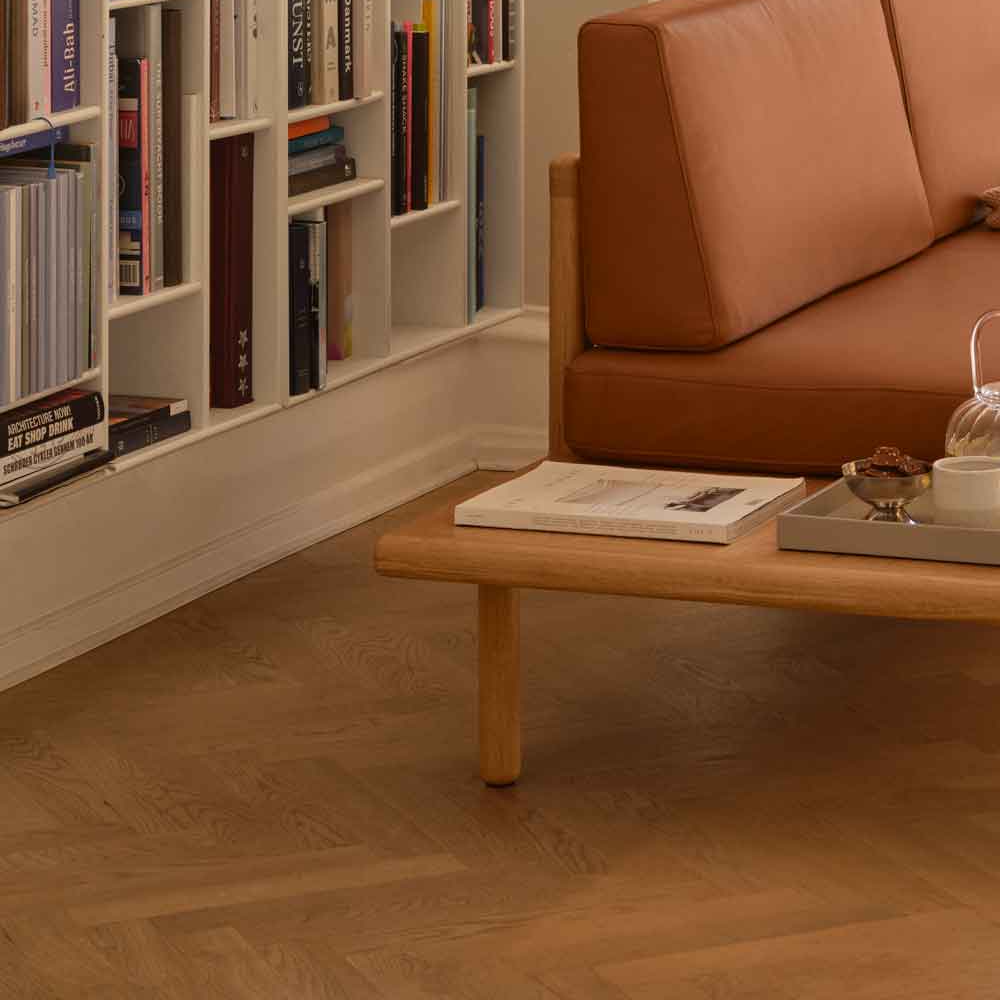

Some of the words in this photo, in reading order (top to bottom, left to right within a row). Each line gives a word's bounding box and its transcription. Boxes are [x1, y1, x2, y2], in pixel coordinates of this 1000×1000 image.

[8, 411, 54, 436] ARCHITECTURE
[8, 433, 24, 452] EAT
[25, 426, 47, 446] SHOP
[48, 417, 73, 437] DRINK
